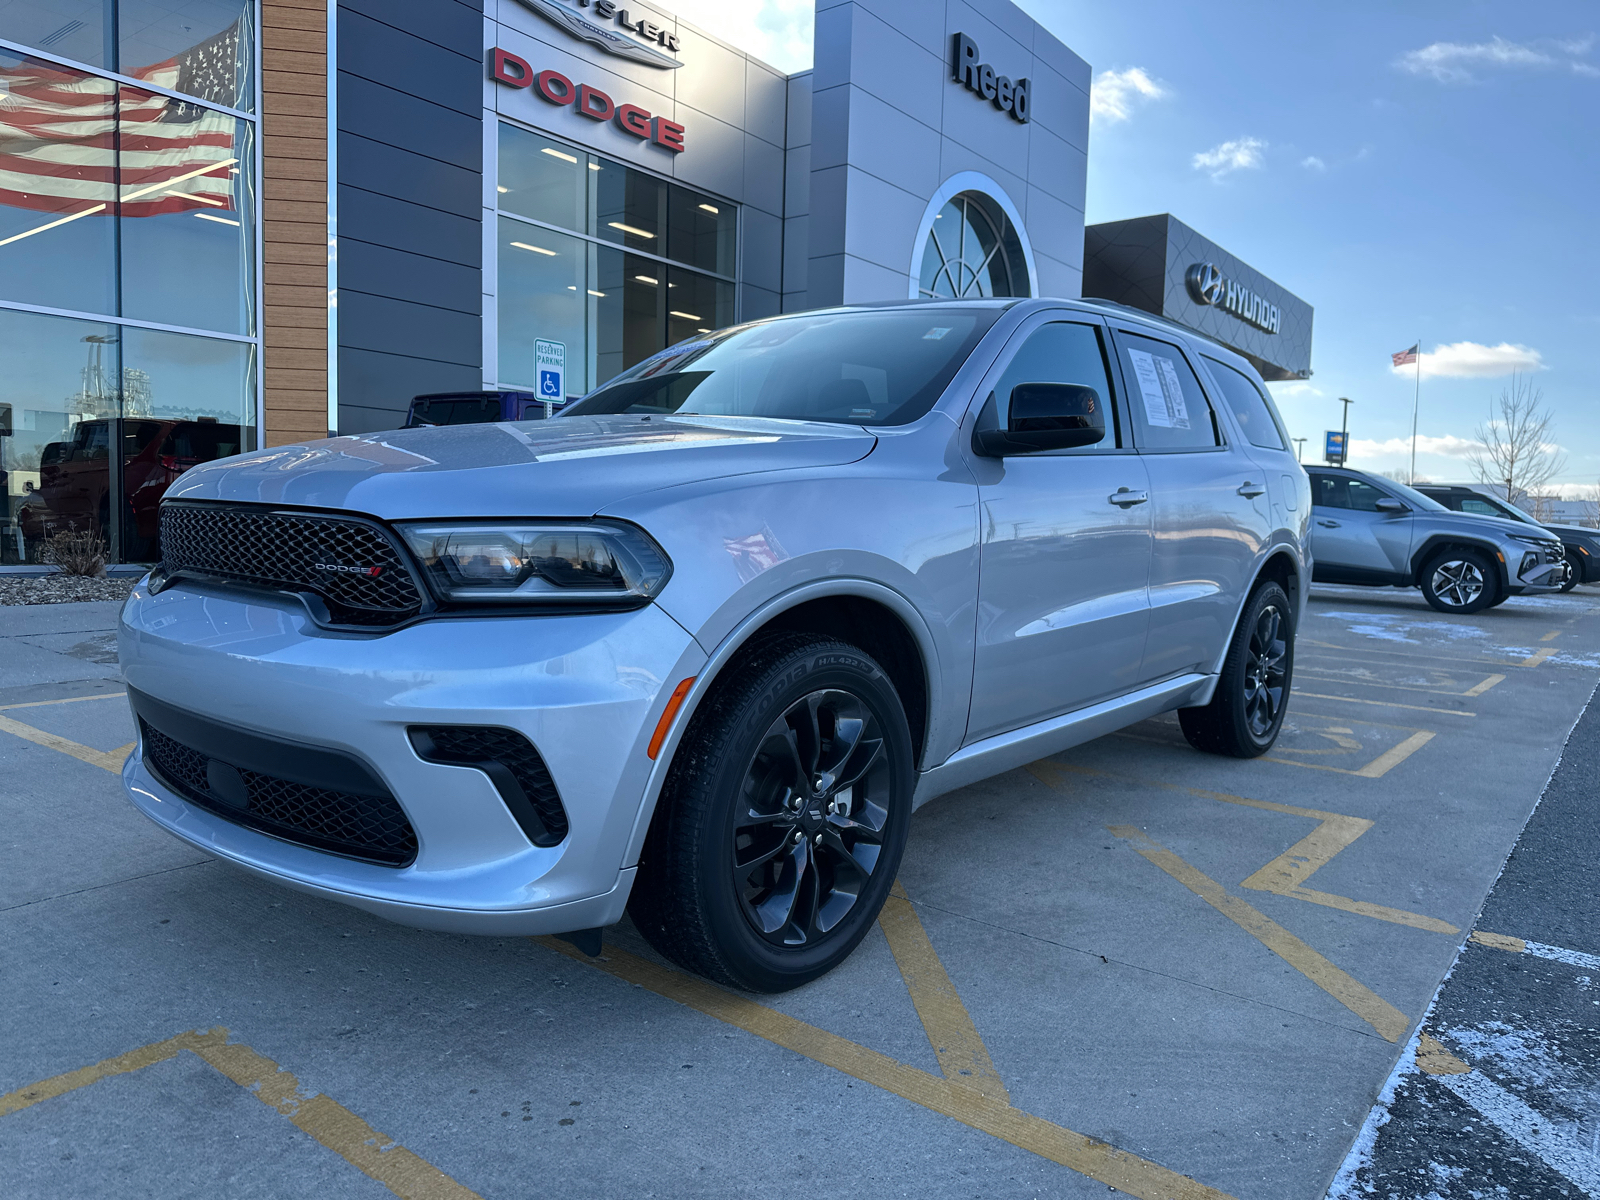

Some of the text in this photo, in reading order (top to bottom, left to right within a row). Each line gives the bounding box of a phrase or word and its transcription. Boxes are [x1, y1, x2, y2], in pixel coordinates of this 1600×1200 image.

[953, 32, 1031, 124] Reed
[489, 47, 685, 153] DODGE
[1225, 279, 1281, 335] HYUNDAI
[537, 344, 563, 357] RESERVED
[537, 355, 563, 367] PARKING
[315, 563, 372, 574] DODGE
[838, 657, 858, 667] 422
